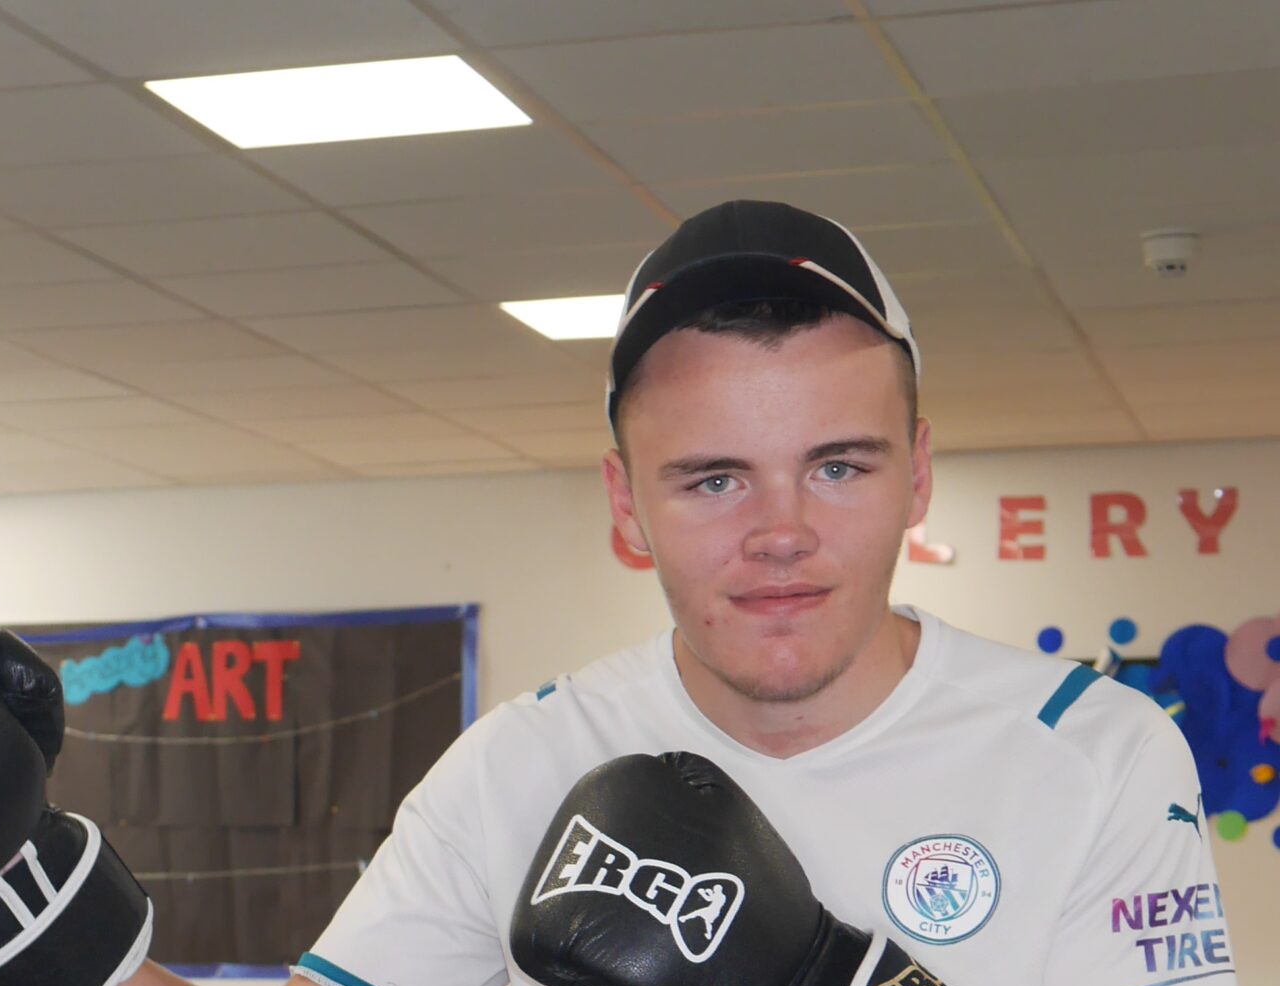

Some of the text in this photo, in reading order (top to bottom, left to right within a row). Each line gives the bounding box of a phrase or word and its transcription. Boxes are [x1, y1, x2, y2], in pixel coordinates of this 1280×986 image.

[162, 640, 301, 721] ART
[900, 842, 990, 878] MANCHESTER
[531, 814, 746, 964] ERGO
[919, 921, 951, 935] CITY
[1135, 928, 1230, 972] TIRE
